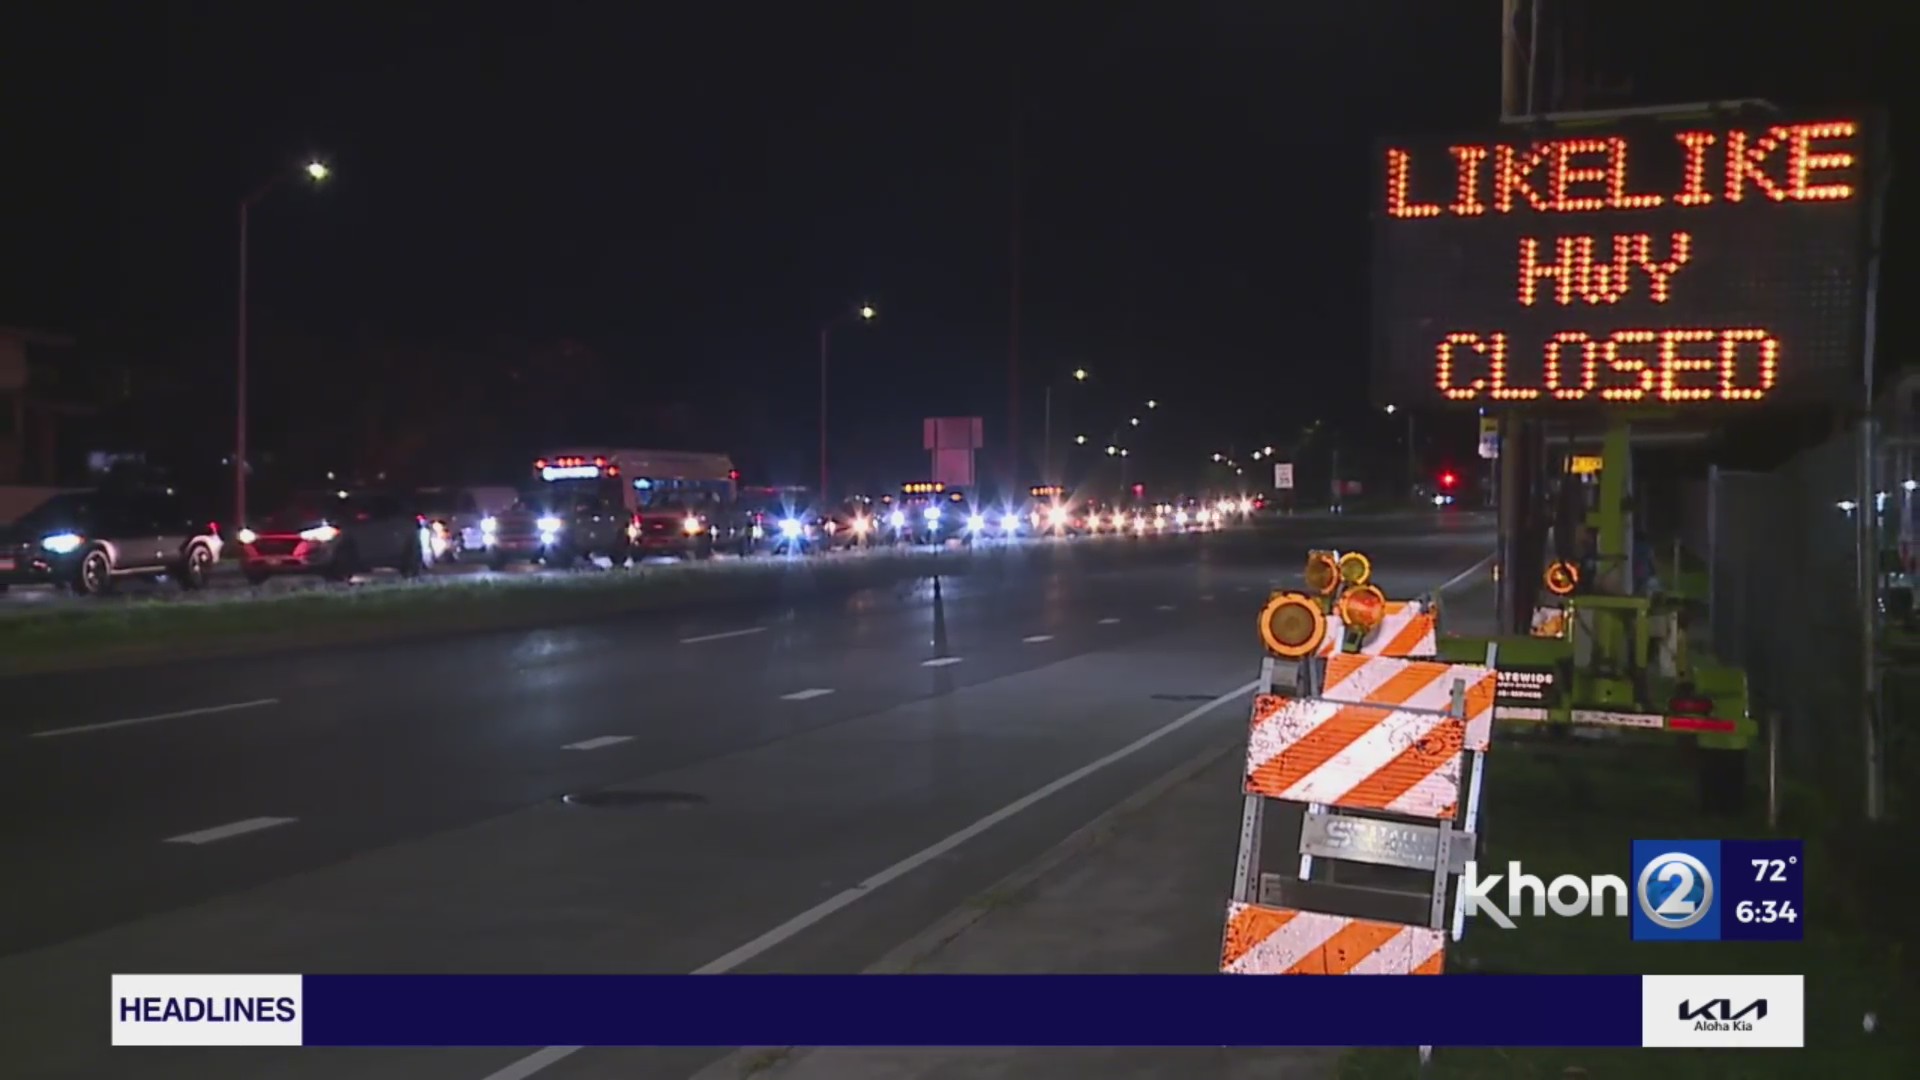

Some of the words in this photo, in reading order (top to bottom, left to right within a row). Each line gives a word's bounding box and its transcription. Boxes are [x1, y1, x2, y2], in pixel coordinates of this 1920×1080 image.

[1386, 120, 1857, 218] LIKELIKE
[1517, 231, 1692, 307] HWY
[1435, 328, 1781, 402] CLOSED
